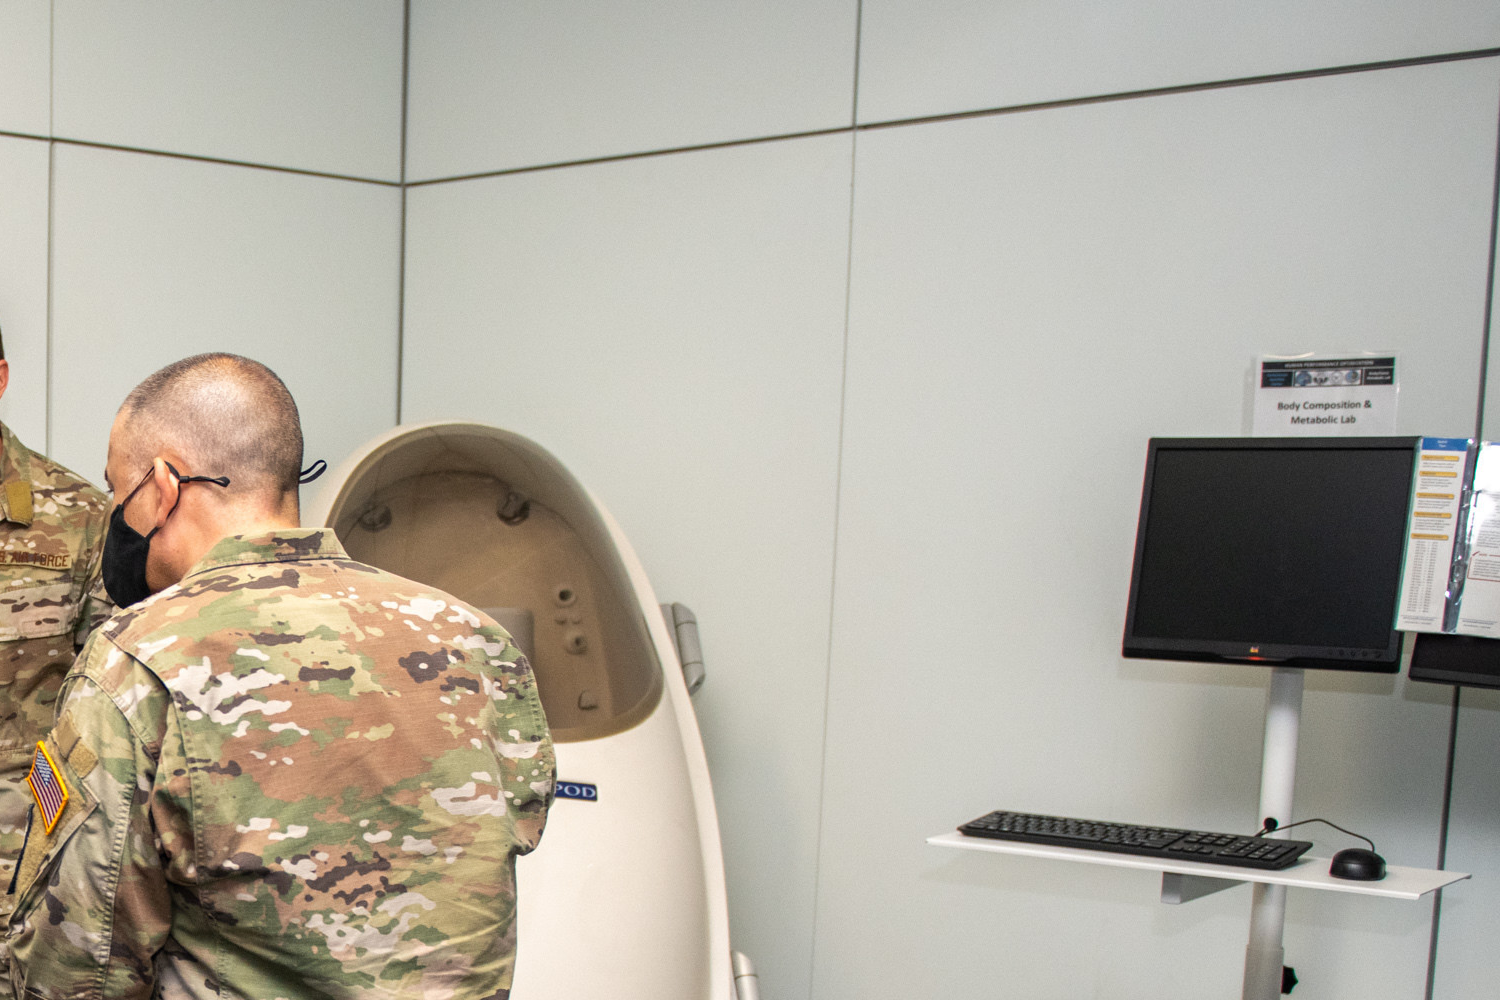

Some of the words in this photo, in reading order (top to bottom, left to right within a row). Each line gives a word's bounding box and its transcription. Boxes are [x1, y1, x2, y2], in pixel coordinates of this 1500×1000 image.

[1277, 402, 1300, 411] Body
[1302, 401, 1361, 410] Composition
[1363, 400, 1372, 408] &
[1291, 416, 1338, 424] Metabolic
[1340, 415, 1356, 424] Lab
[10, 551, 29, 563] AIR
[33, 552, 70, 567] FORCE
